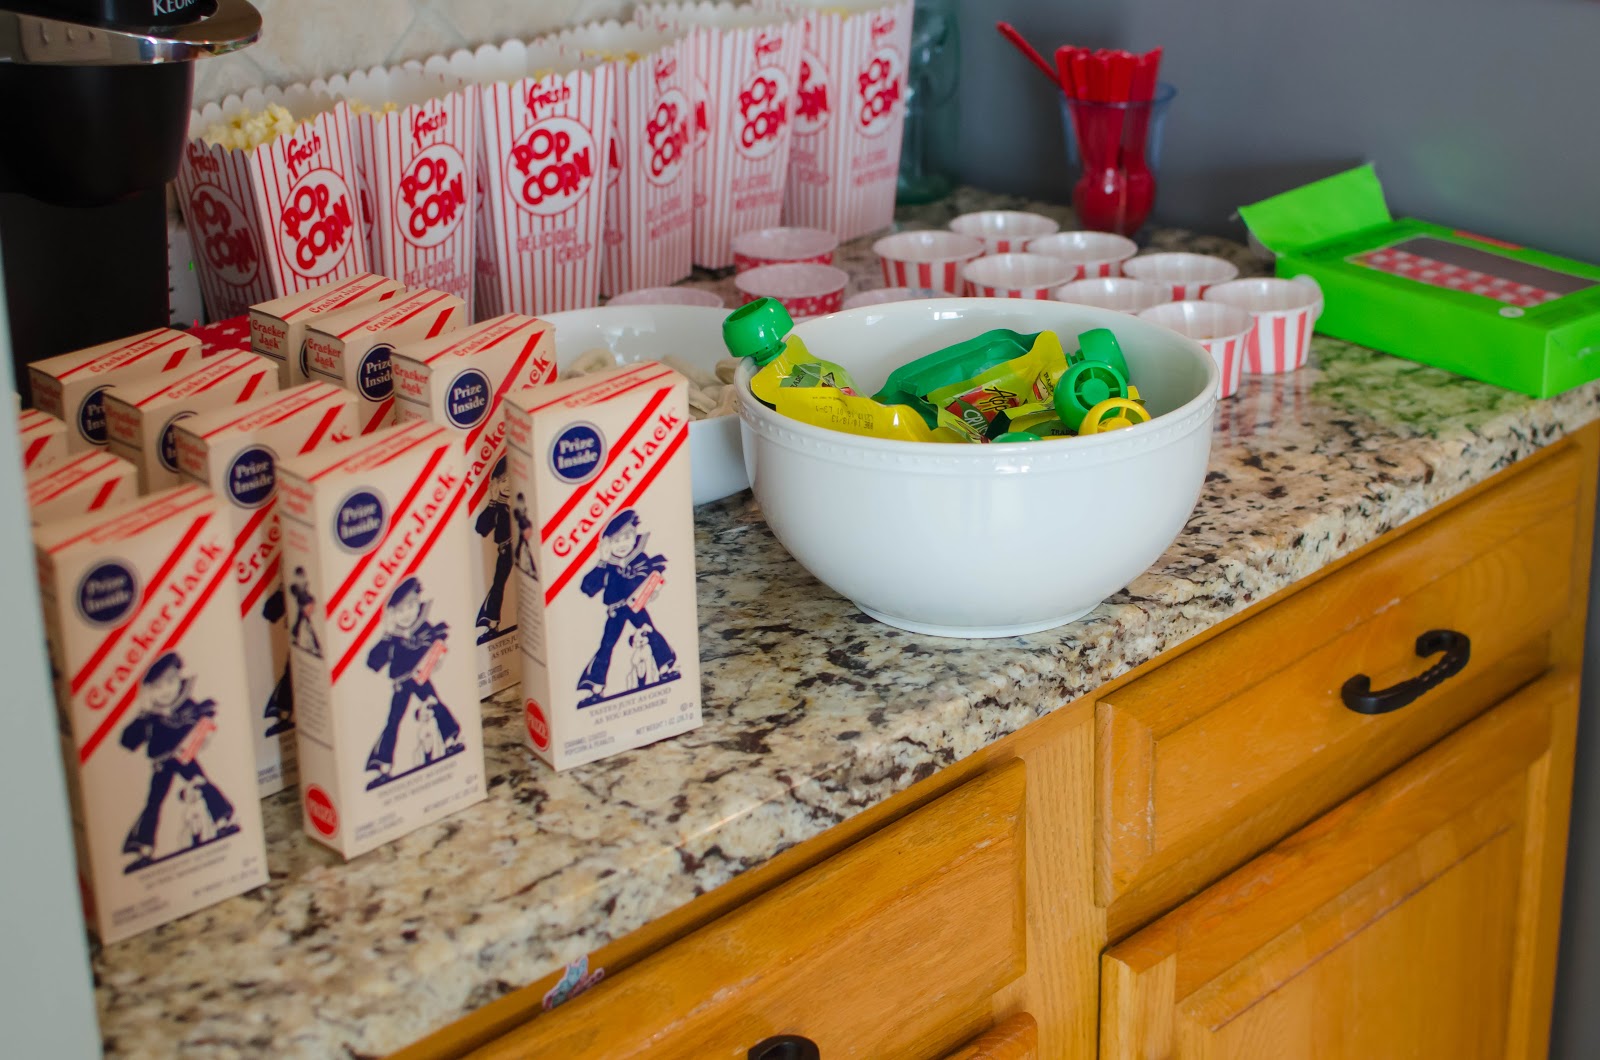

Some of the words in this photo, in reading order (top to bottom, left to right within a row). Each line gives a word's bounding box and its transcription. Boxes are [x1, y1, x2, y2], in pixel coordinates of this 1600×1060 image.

[152, 0, 195, 16] KEU
[511, 129, 570, 176] POP
[523, 147, 591, 205] CORN
[400, 157, 447, 209] POP
[409, 172, 465, 238] CORN
[282, 184, 329, 241] POP
[296, 194, 352, 269] CORN
[252, 320, 285, 338] Cracker
[258, 333, 279, 349] Jack
[365, 370, 392, 388] Insid
[454, 384, 482, 400] Prize
[453, 395, 485, 415] Inside
[557, 450, 598, 470] Inside
[559, 436, 595, 452] Prize
[552, 466, 634, 557] Cracker
[631, 411, 680, 470] Jack
[337, 531, 413, 631] Cracker
[411, 473, 456, 534] Jack
[84, 602, 177, 711] Cracker
[168, 542, 223, 606] Jack
